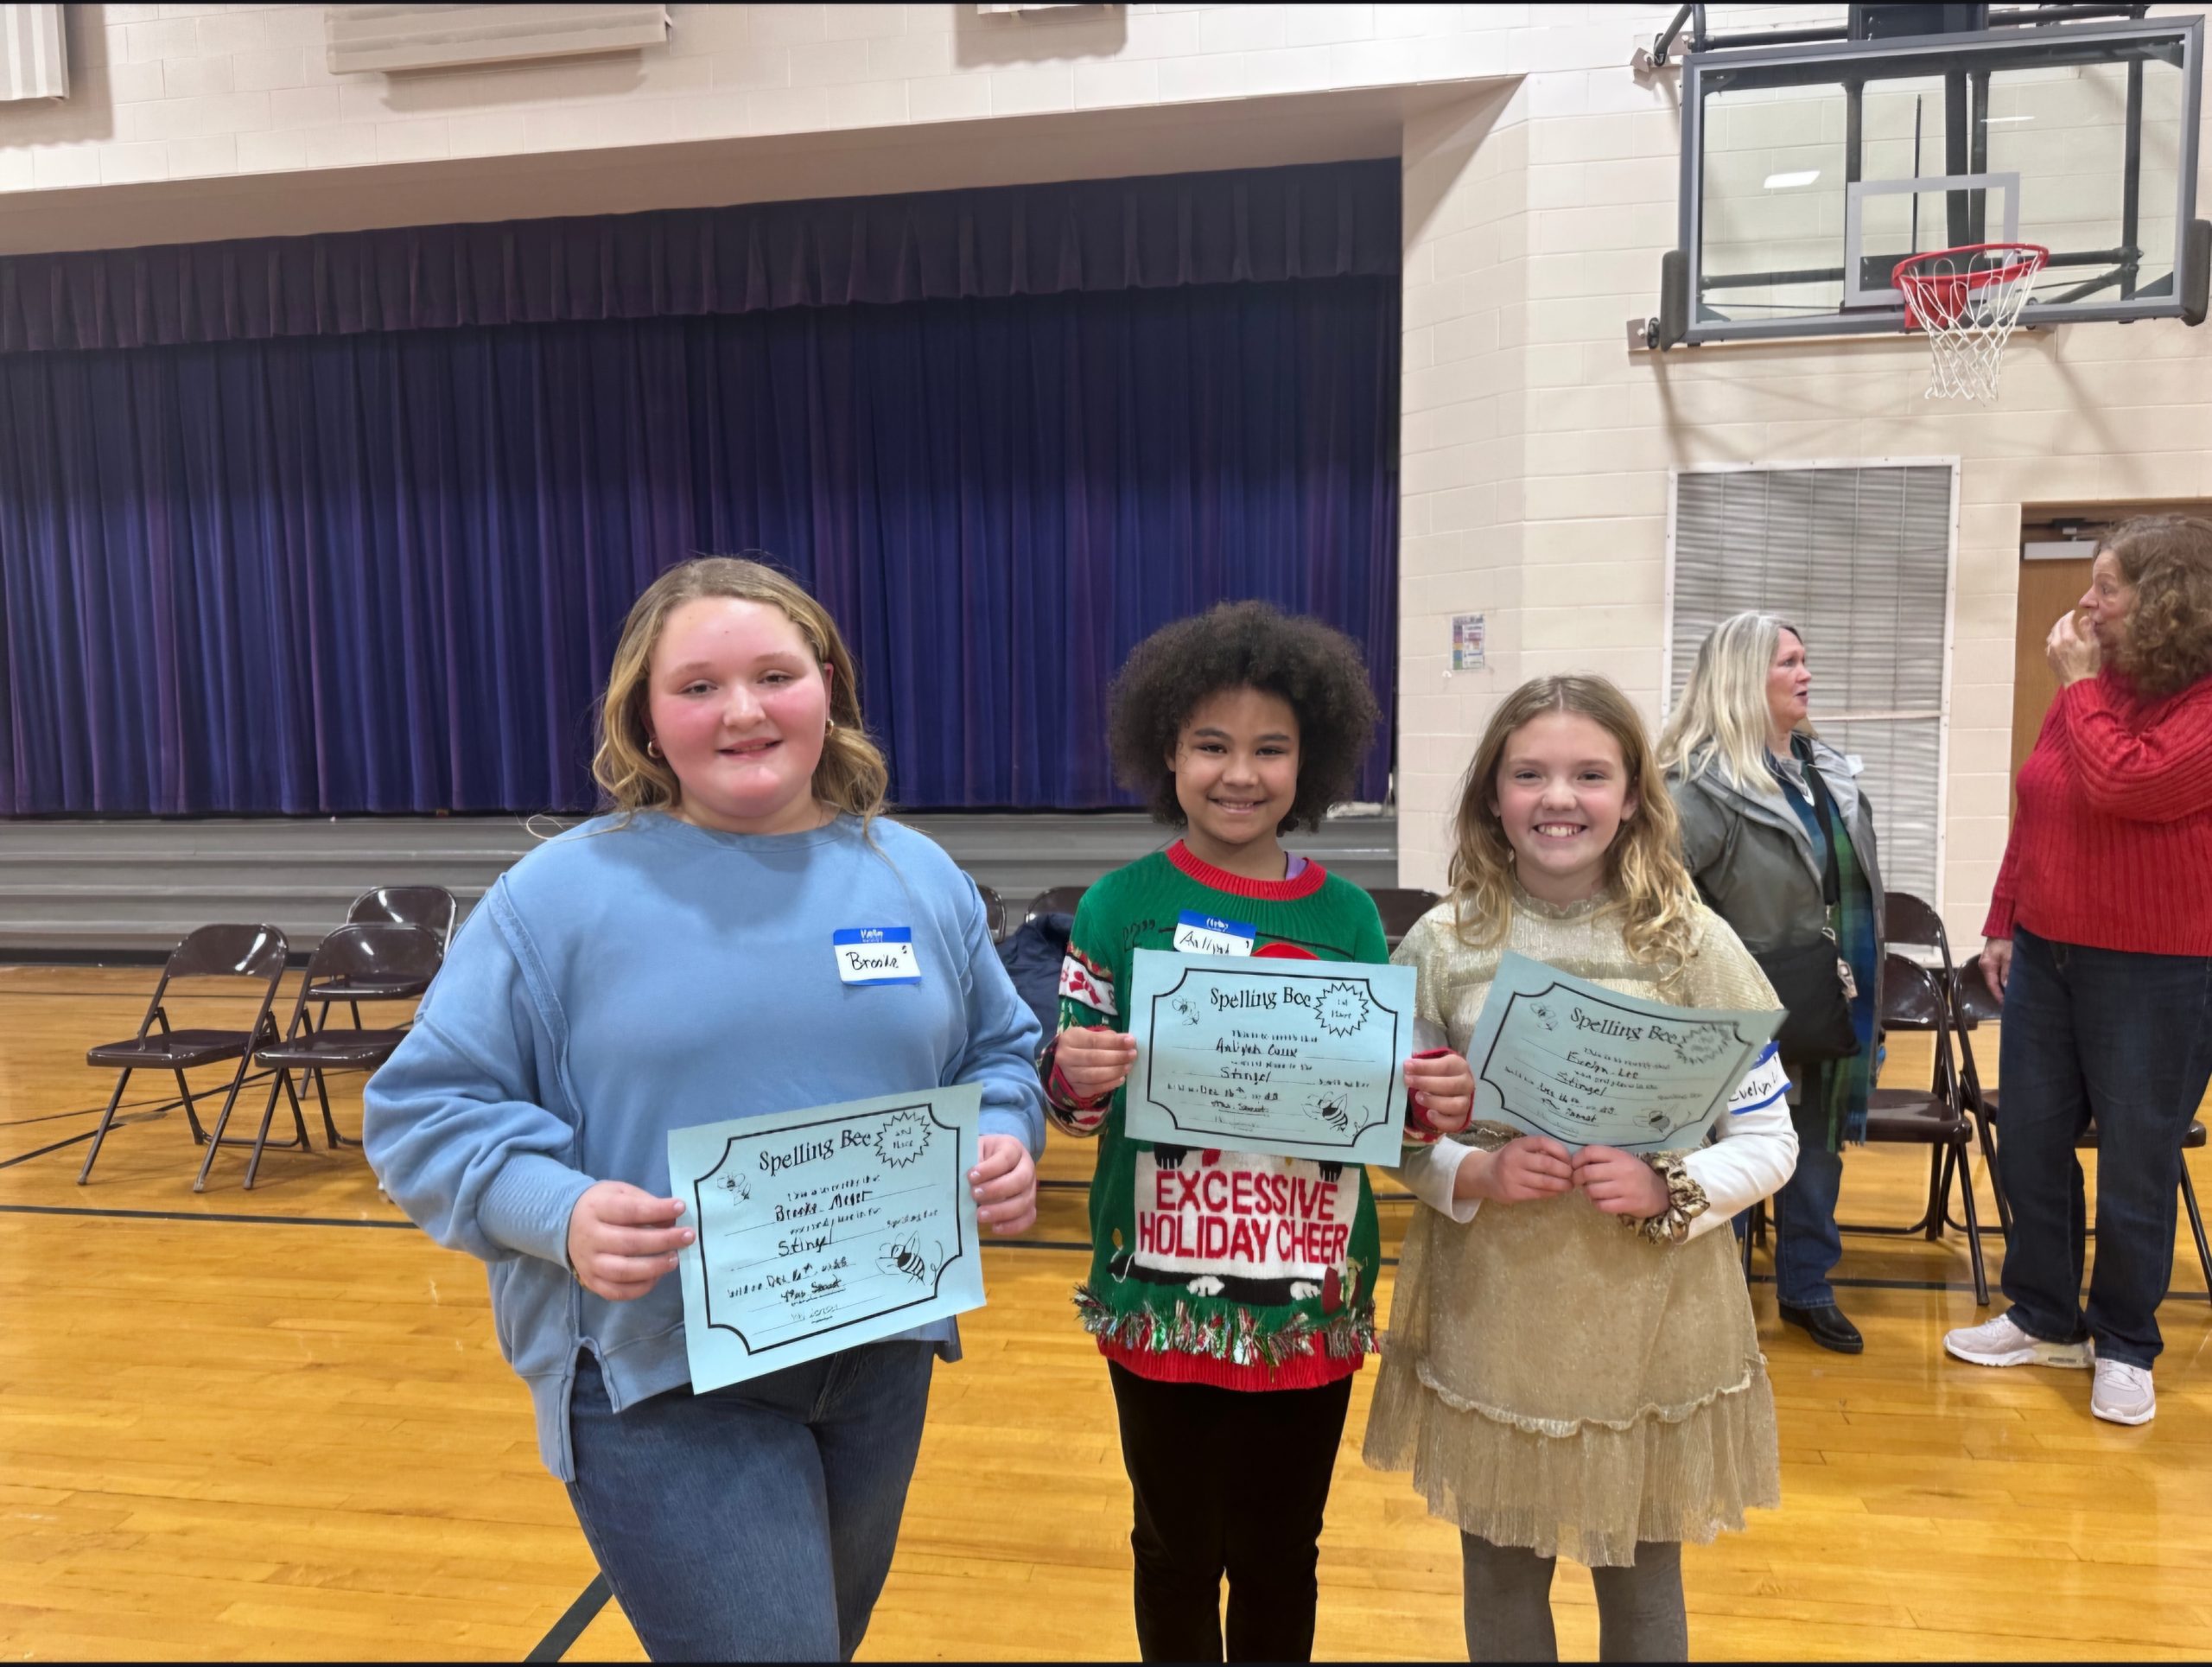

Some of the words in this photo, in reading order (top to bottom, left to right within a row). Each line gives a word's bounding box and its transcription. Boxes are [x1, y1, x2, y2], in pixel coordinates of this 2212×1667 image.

[1210, 988, 1277, 1012] Spelling
[1283, 987, 1312, 1008] Bee
[1570, 1007, 1643, 1042] Spelling
[1648, 1026, 1678, 1046] Bee
[760, 1139, 834, 1176] Spelling
[839, 1129, 871, 1149] Bee
[1156, 1170, 1338, 1221] EXCESSIVE
[1140, 1212, 1271, 1263] HOLIDAY
[1276, 1219, 1349, 1264] CHEER
